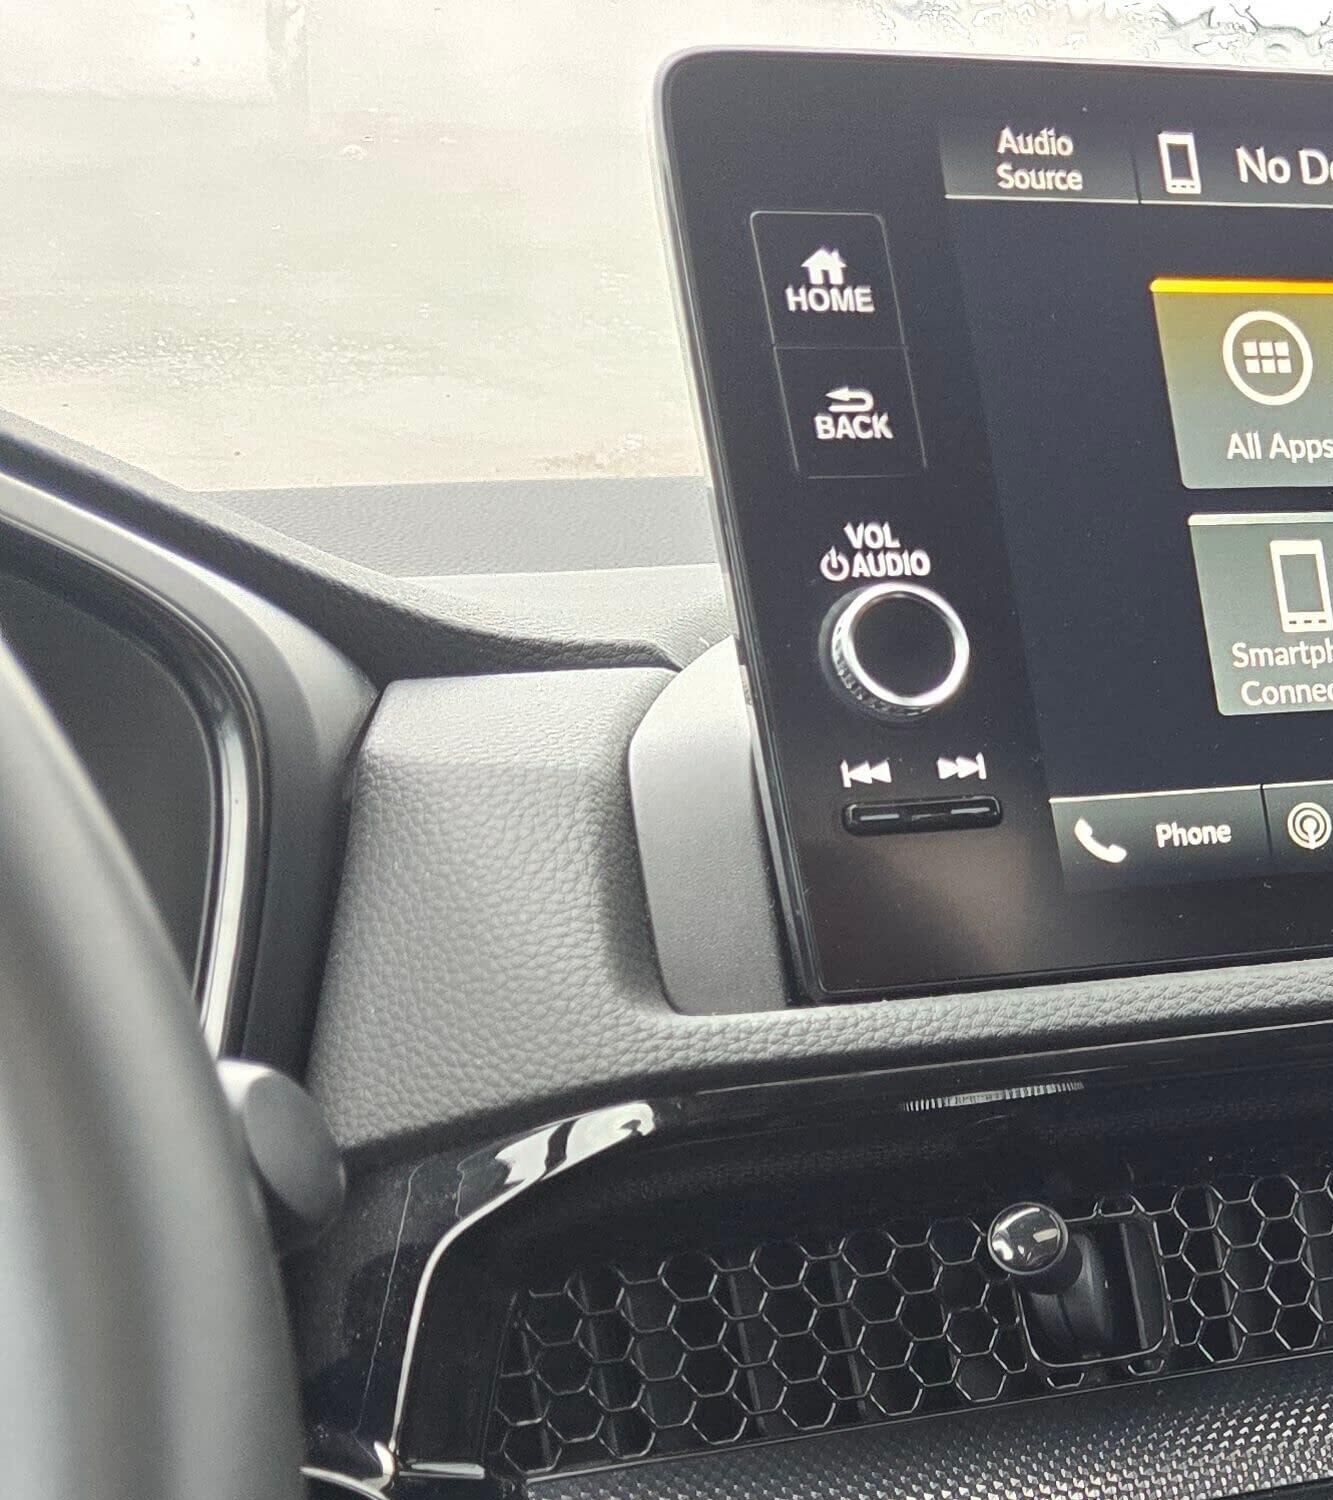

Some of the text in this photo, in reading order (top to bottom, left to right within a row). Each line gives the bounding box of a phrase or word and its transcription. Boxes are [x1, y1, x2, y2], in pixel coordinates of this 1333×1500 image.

[997, 127, 1074, 158] Audio
[996, 163, 1084, 192] Source
[1235, 146, 1292, 186] No
[785, 285, 875, 314] HOME
[814, 413, 894, 440] BACK
[1226, 432, 1263, 461] All
[843, 521, 900, 550] VOL
[851, 550, 932, 579] AUDIO
[1155, 820, 1232, 848] Phone
